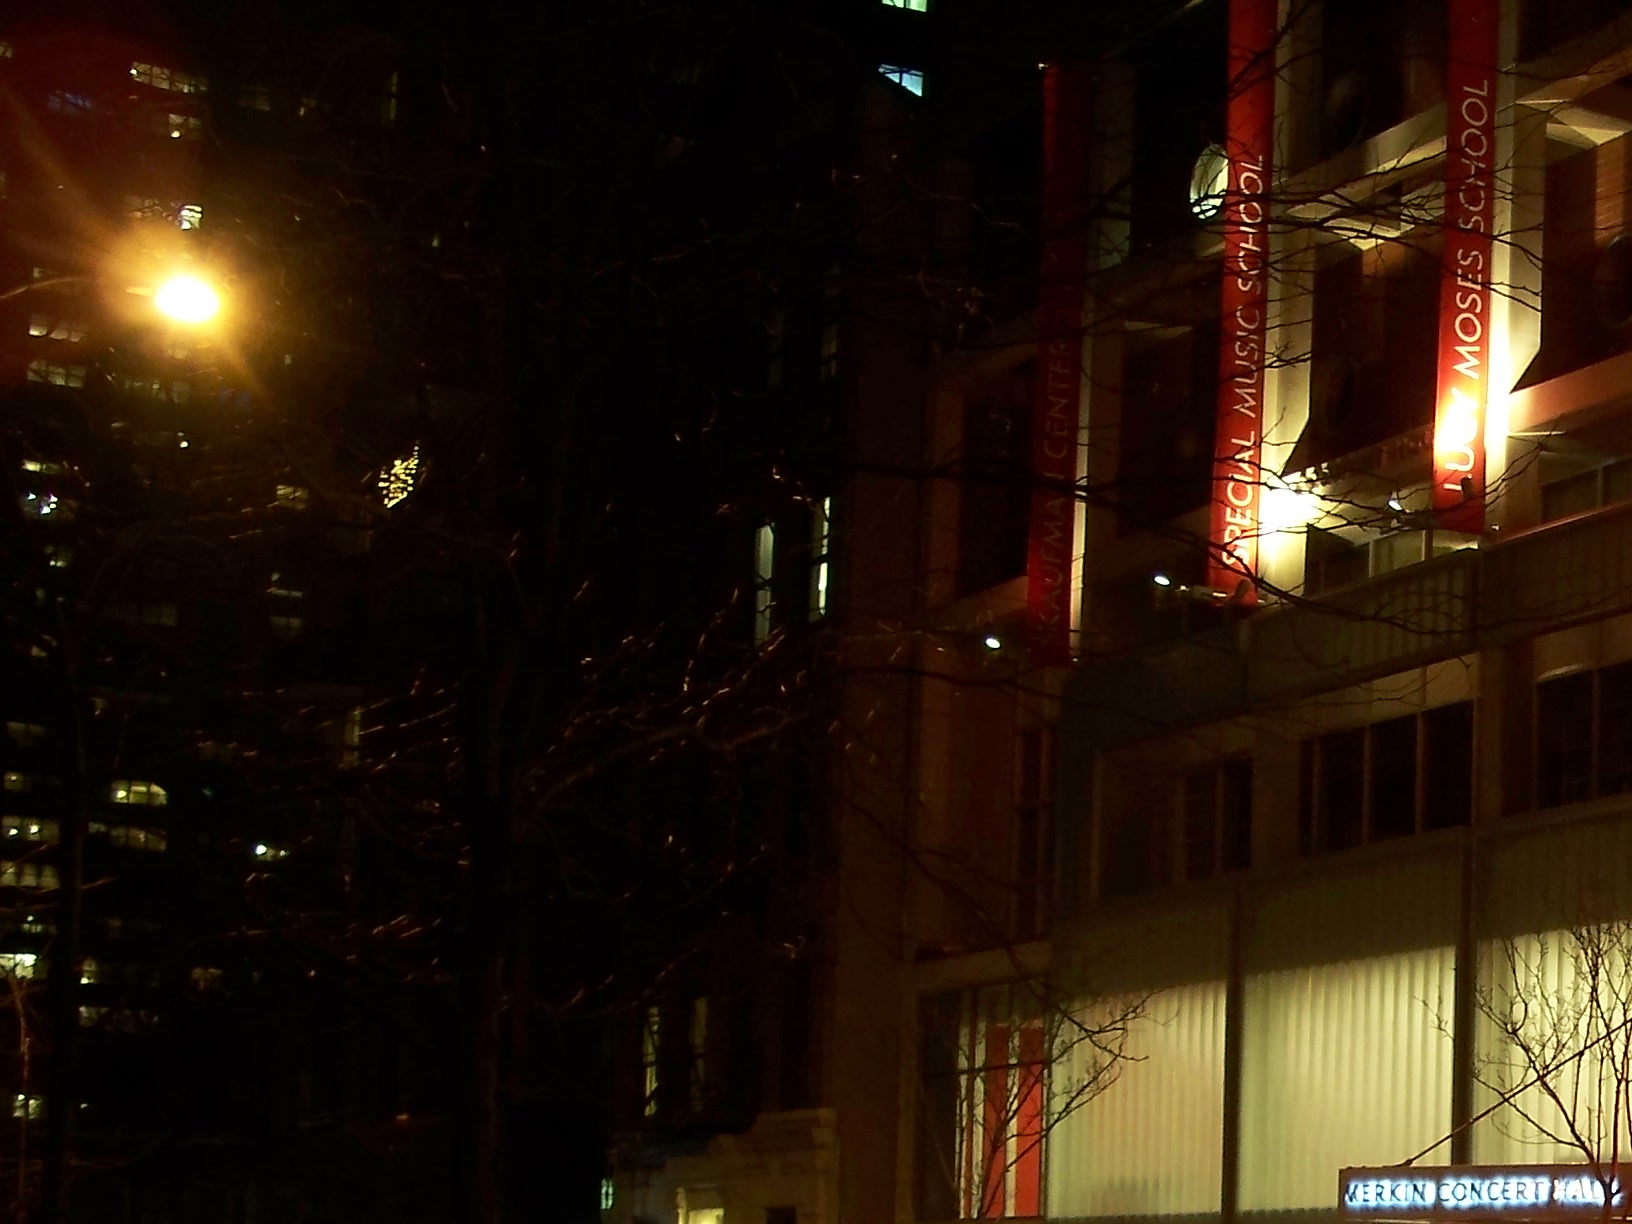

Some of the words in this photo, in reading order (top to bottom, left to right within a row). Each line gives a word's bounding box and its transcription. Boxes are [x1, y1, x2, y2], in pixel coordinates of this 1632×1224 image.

[1458, 79, 1488, 233] SCHOOL
[1236, 155, 1264, 296] SCHOOL
[1232, 305, 1260, 418] MUSIC
[1452, 249, 1484, 380] MOSES
[1222, 430, 1257, 566] SPECIAL
[1347, 1180, 1428, 1204] MERKIN
[1438, 1179, 1547, 1204] CONCERT
